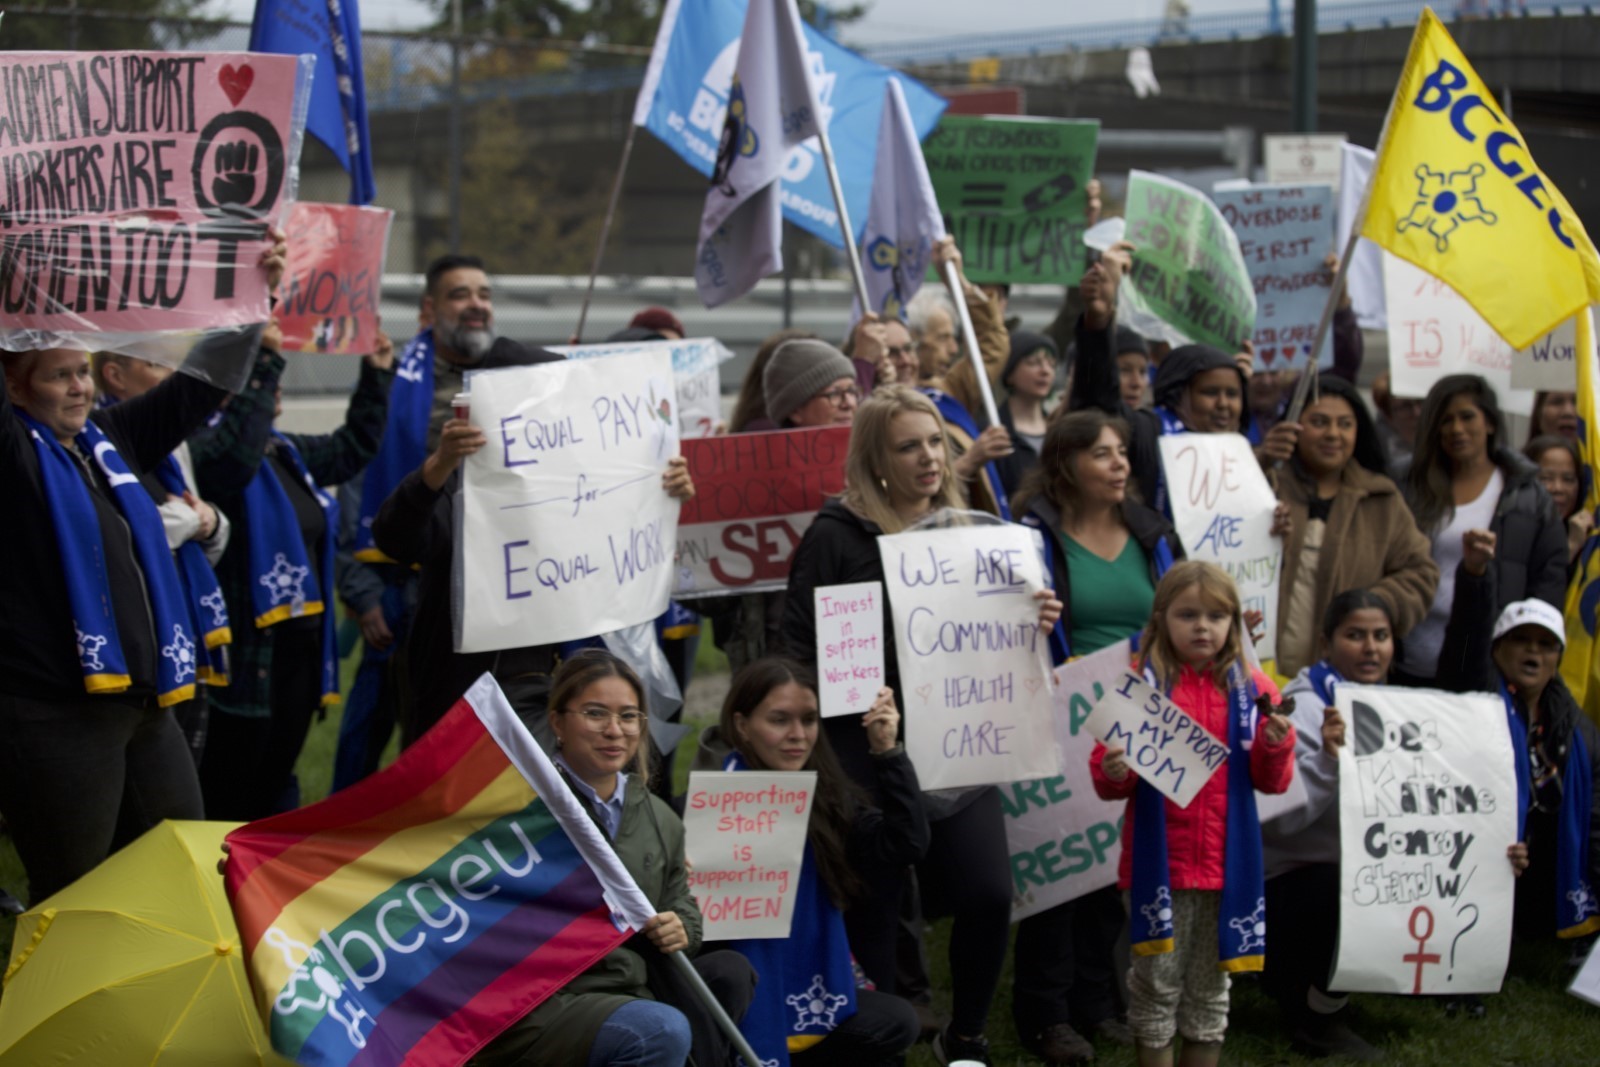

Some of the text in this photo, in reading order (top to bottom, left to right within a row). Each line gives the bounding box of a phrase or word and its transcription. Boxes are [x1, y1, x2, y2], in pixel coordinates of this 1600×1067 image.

[90, 55, 205, 137] SUPPORT
[109, 139, 177, 212] ARE
[1146, 186, 1193, 227] WE
[1221, 203, 1323, 228] OVERDOSE
[1241, 193, 1263, 205] WE
[117, 221, 193, 312] TOO
[1240, 237, 1315, 264] FIRST
[280, 267, 376, 316] WOMEN
[1403, 319, 1443, 359] IS
[501, 393, 643, 468] EQUAL PAY
[572, 473, 599, 517] for
[1176, 445, 1240, 510] WE
[1194, 514, 1244, 556] ARE
[503, 518, 668, 600] EQUAL WORK
[900, 546, 1027, 587] WE ARE
[821, 591, 874, 618] Invest
[825, 634, 878, 659] support
[840, 619, 854, 637] in
[908, 606, 1041, 656] COMMUNITY
[944, 671, 1013, 708] HEALTH
[943, 720, 1015, 759] CARE
[1116, 673, 1232, 771] I SUPPORT
[1139, 720, 1175, 750] MY
[1351, 700, 1442, 756] Does
[1103, 721, 1187, 793] MOM
[1356, 757, 1497, 818] Katrine
[733, 844, 753, 863] is
[1364, 822, 1475, 872] Conroy
[320, 821, 543, 992] bcgeu
[1352, 863, 1433, 906] Stand
[1447, 903, 1480, 983] ?
